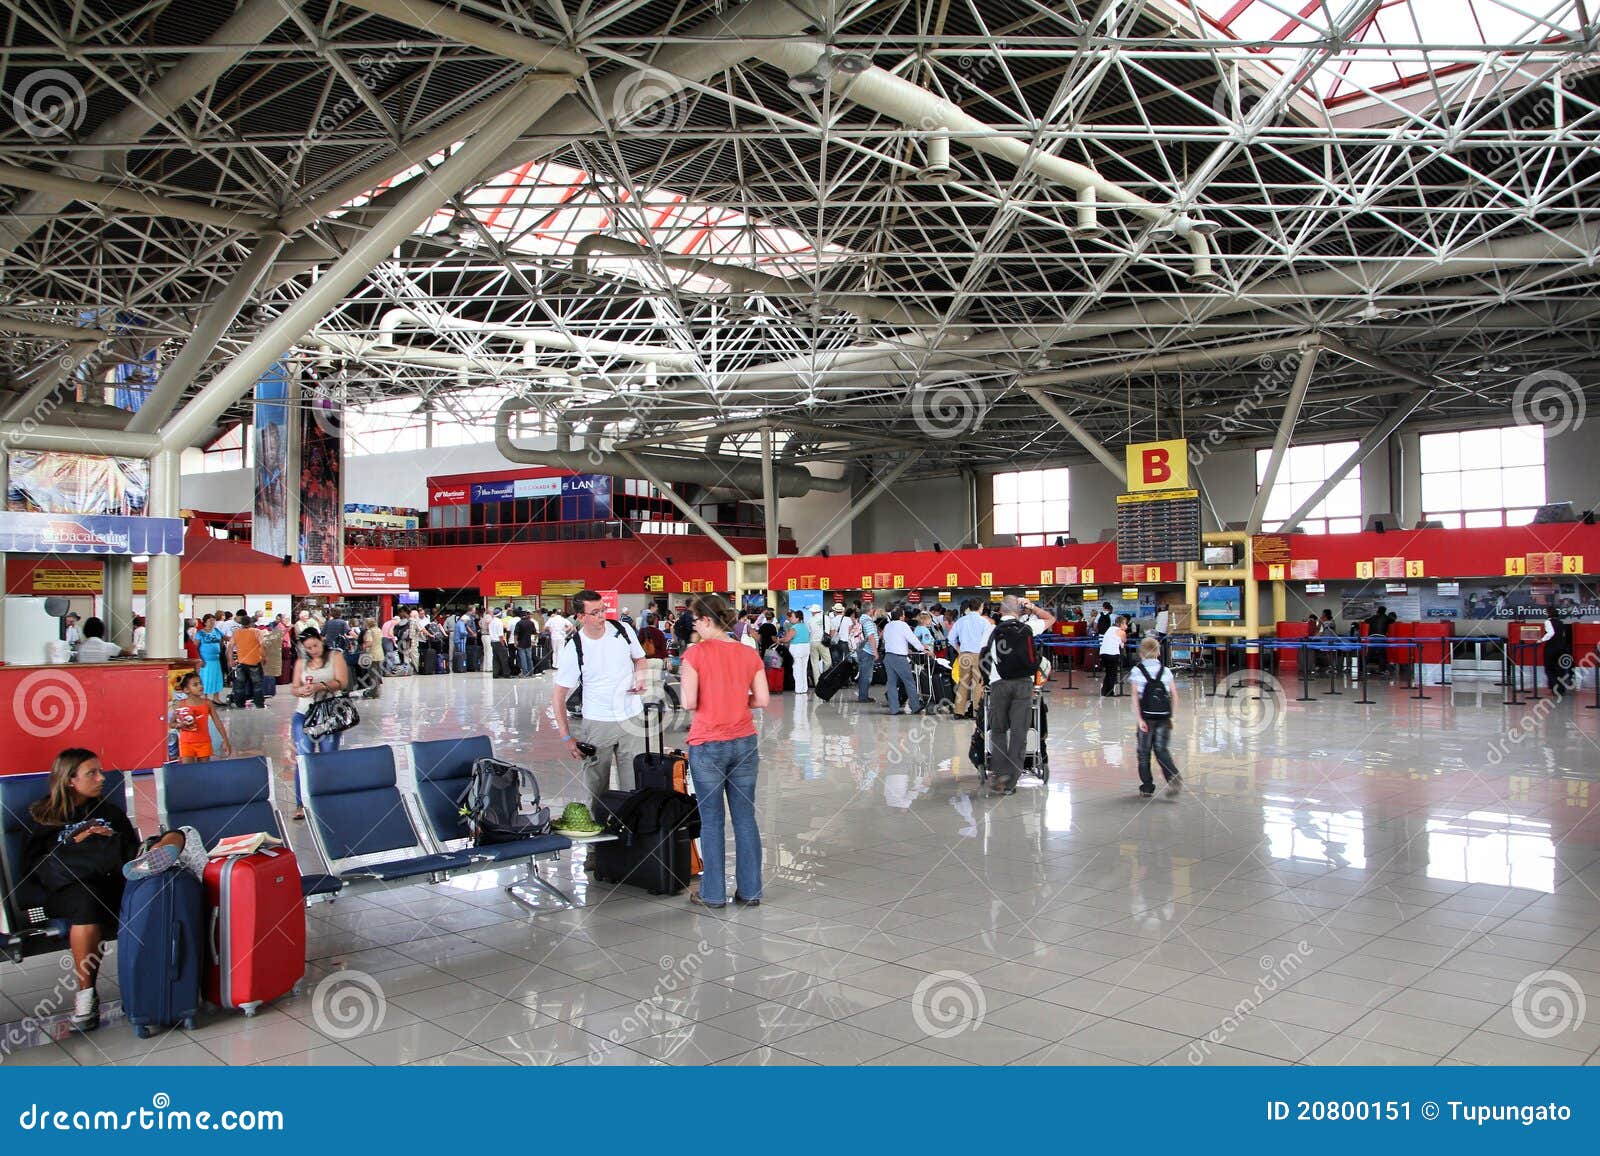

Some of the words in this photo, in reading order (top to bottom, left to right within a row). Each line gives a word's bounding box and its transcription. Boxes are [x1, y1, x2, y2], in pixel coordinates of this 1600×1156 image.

[1142, 448, 1171, 484] B
[571, 480, 594, 490] LAN
[1274, 565, 1280, 579] 7
[1361, 562, 1368, 576] 6
[1411, 561, 1418, 576] 5
[1511, 560, 1518, 574] 4
[1569, 557, 1577, 573] 3
[1496, 606, 1514, 616] Los
[1517, 605, 1567, 616] Primes
